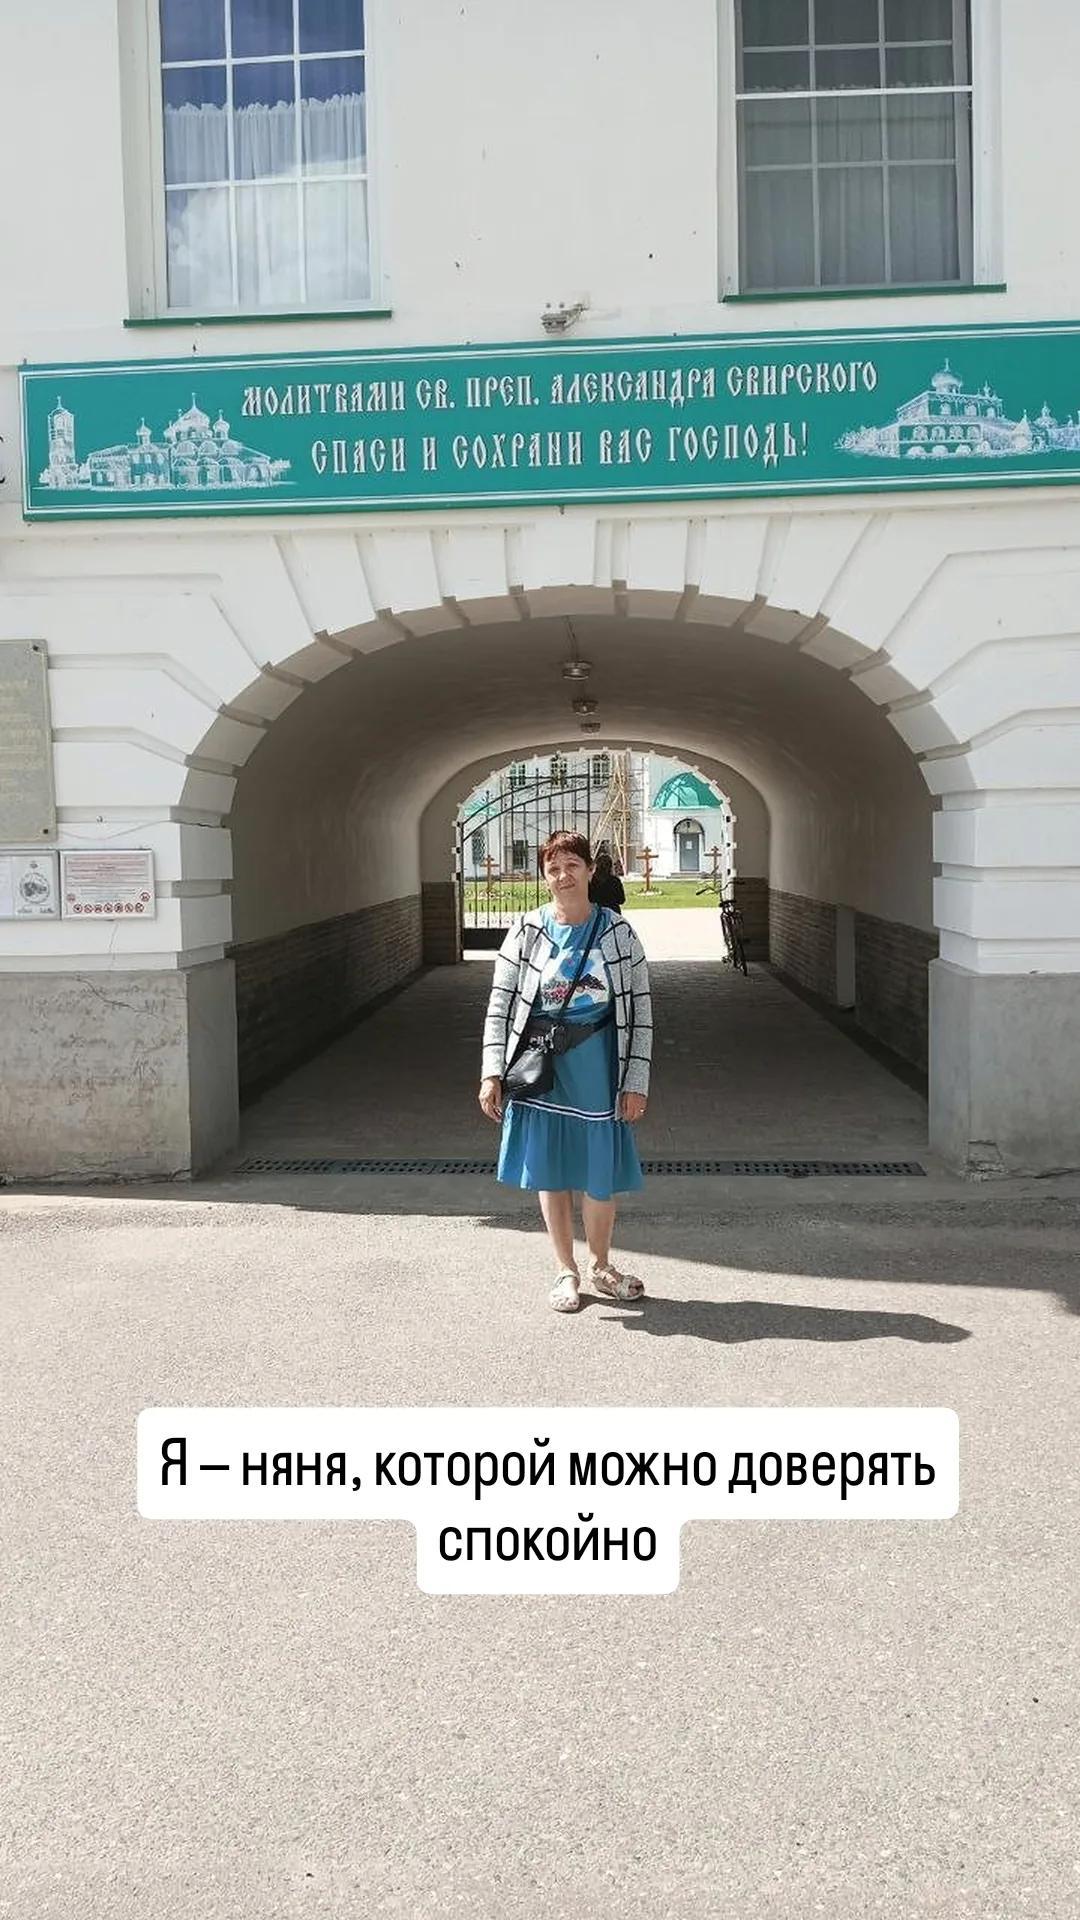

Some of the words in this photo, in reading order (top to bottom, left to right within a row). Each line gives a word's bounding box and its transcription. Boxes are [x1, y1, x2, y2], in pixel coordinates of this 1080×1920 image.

[242, 378, 406, 417] МОЛИТВАМИ
[415, 378, 456, 411] СВ.
[466, 374, 540, 409] ПРЕП.
[551, 367, 716, 408] АЛЕКСАНДРА
[727, 361, 879, 397] СВИРСКОГО
[311, 437, 407, 475] СПАСИ
[422, 437, 438, 471] И
[452, 430, 583, 469] СОХРАНИ
[599, 427, 653, 464] ВАС
[668, 421, 809, 467] ГОСПОДЬ!
